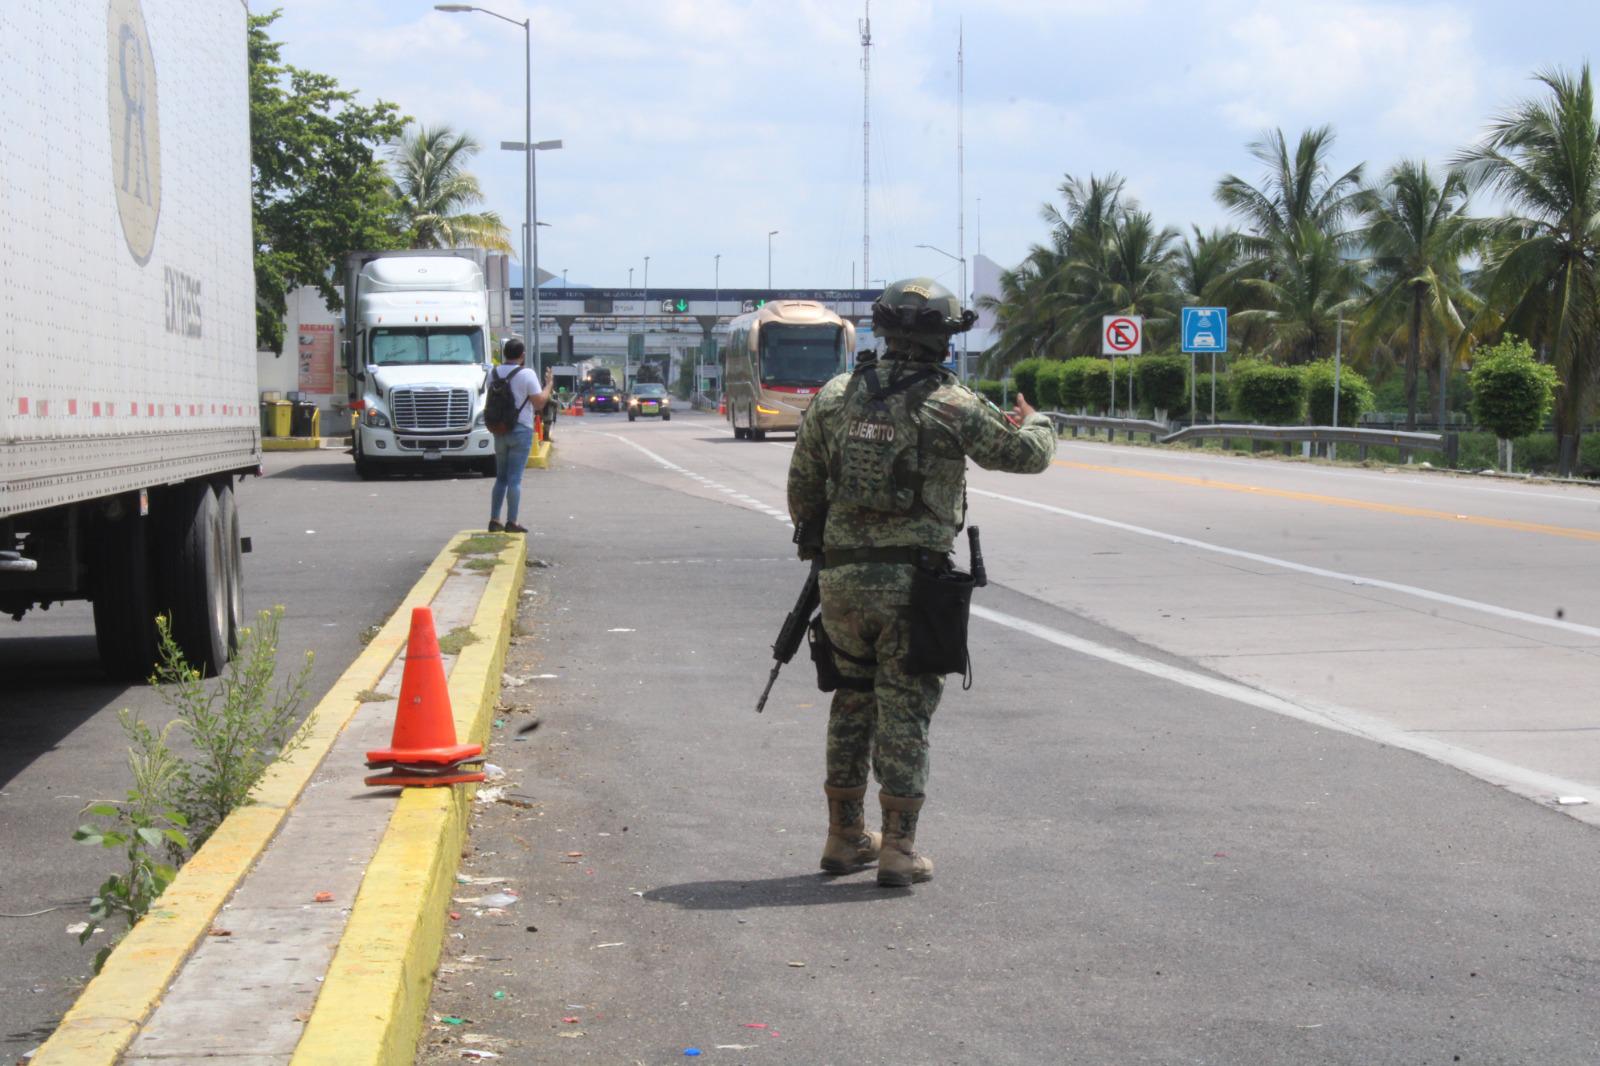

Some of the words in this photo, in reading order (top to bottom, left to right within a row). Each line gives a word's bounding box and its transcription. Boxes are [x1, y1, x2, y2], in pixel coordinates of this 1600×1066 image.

[164, 265, 202, 338] EXPRESS
[299, 324, 335, 333] MENU
[849, 419, 894, 441] EJÉRCITO
